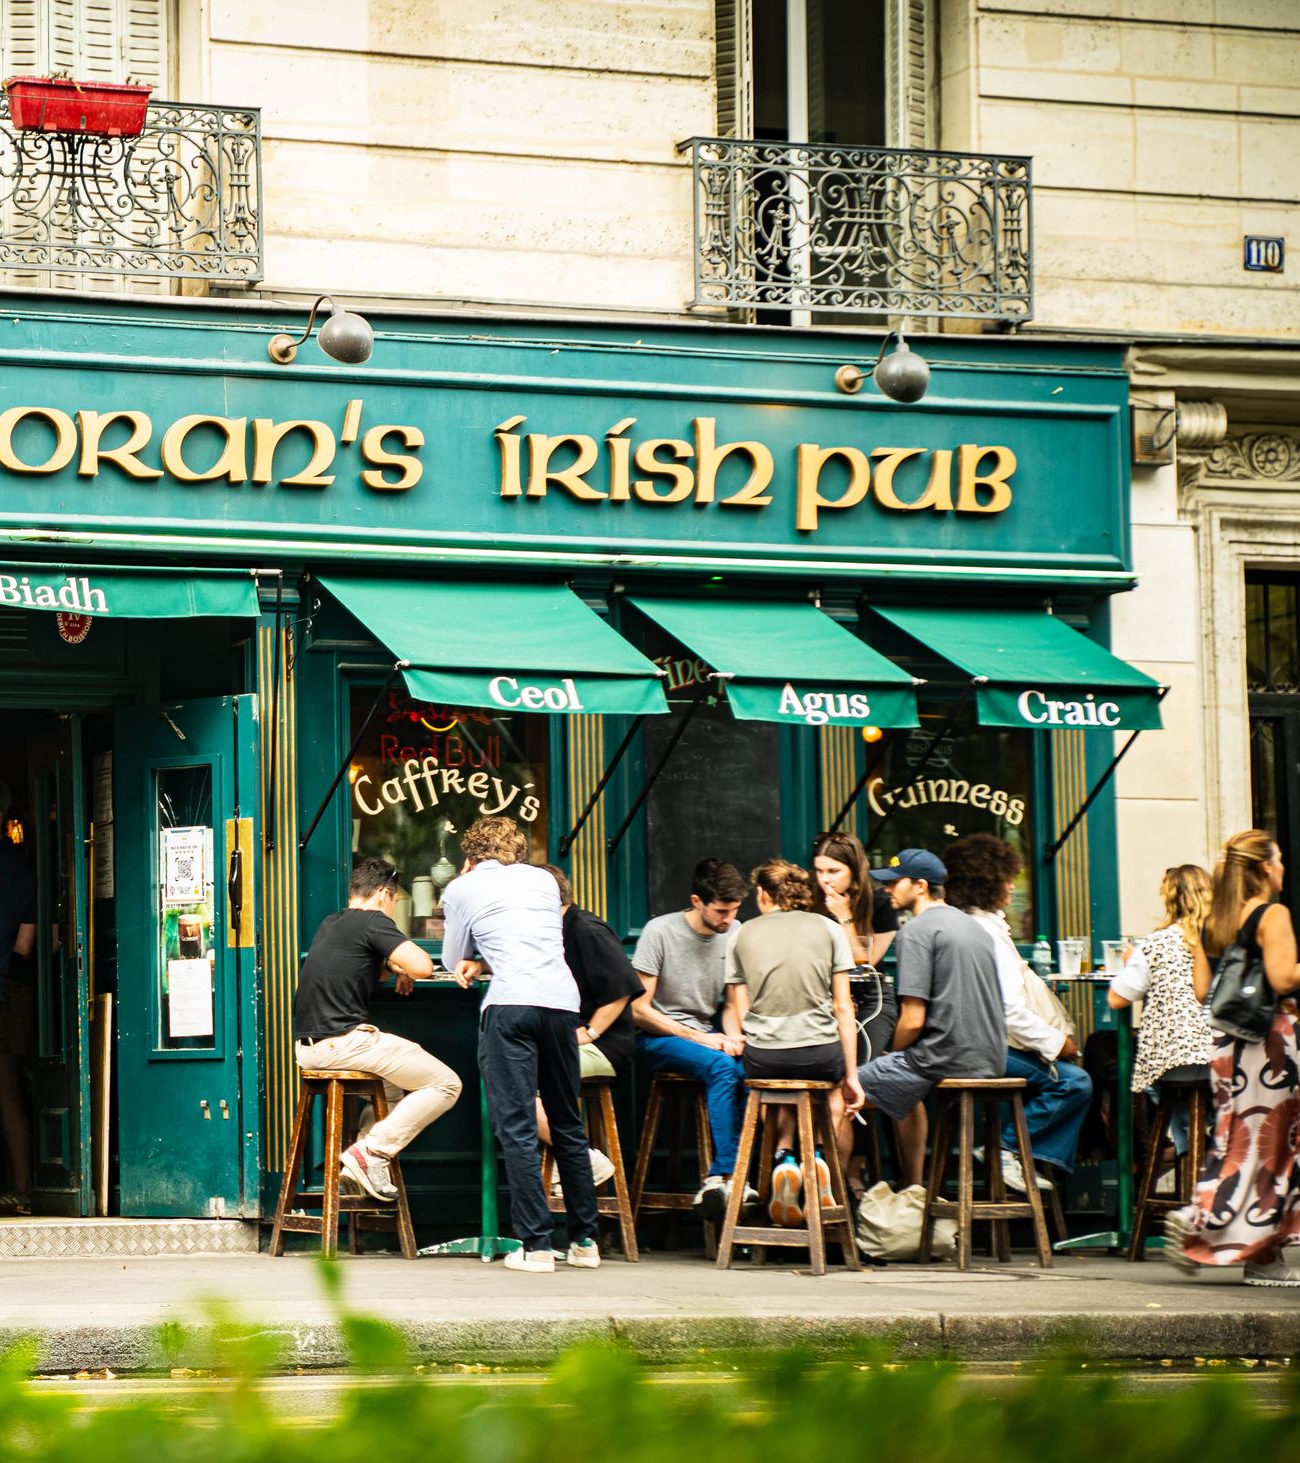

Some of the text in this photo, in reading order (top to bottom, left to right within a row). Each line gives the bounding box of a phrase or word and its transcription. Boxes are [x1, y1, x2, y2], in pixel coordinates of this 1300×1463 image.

[1250, 240, 1280, 267] 110
[796, 443, 1018, 530] PUB
[488, 676, 584, 711] Ceol
[778, 682, 870, 725] Agus
[1018, 690, 1121, 727] Craic
[381, 735, 500, 769] Red Bull
[354, 757, 541, 822] Caffrey's
